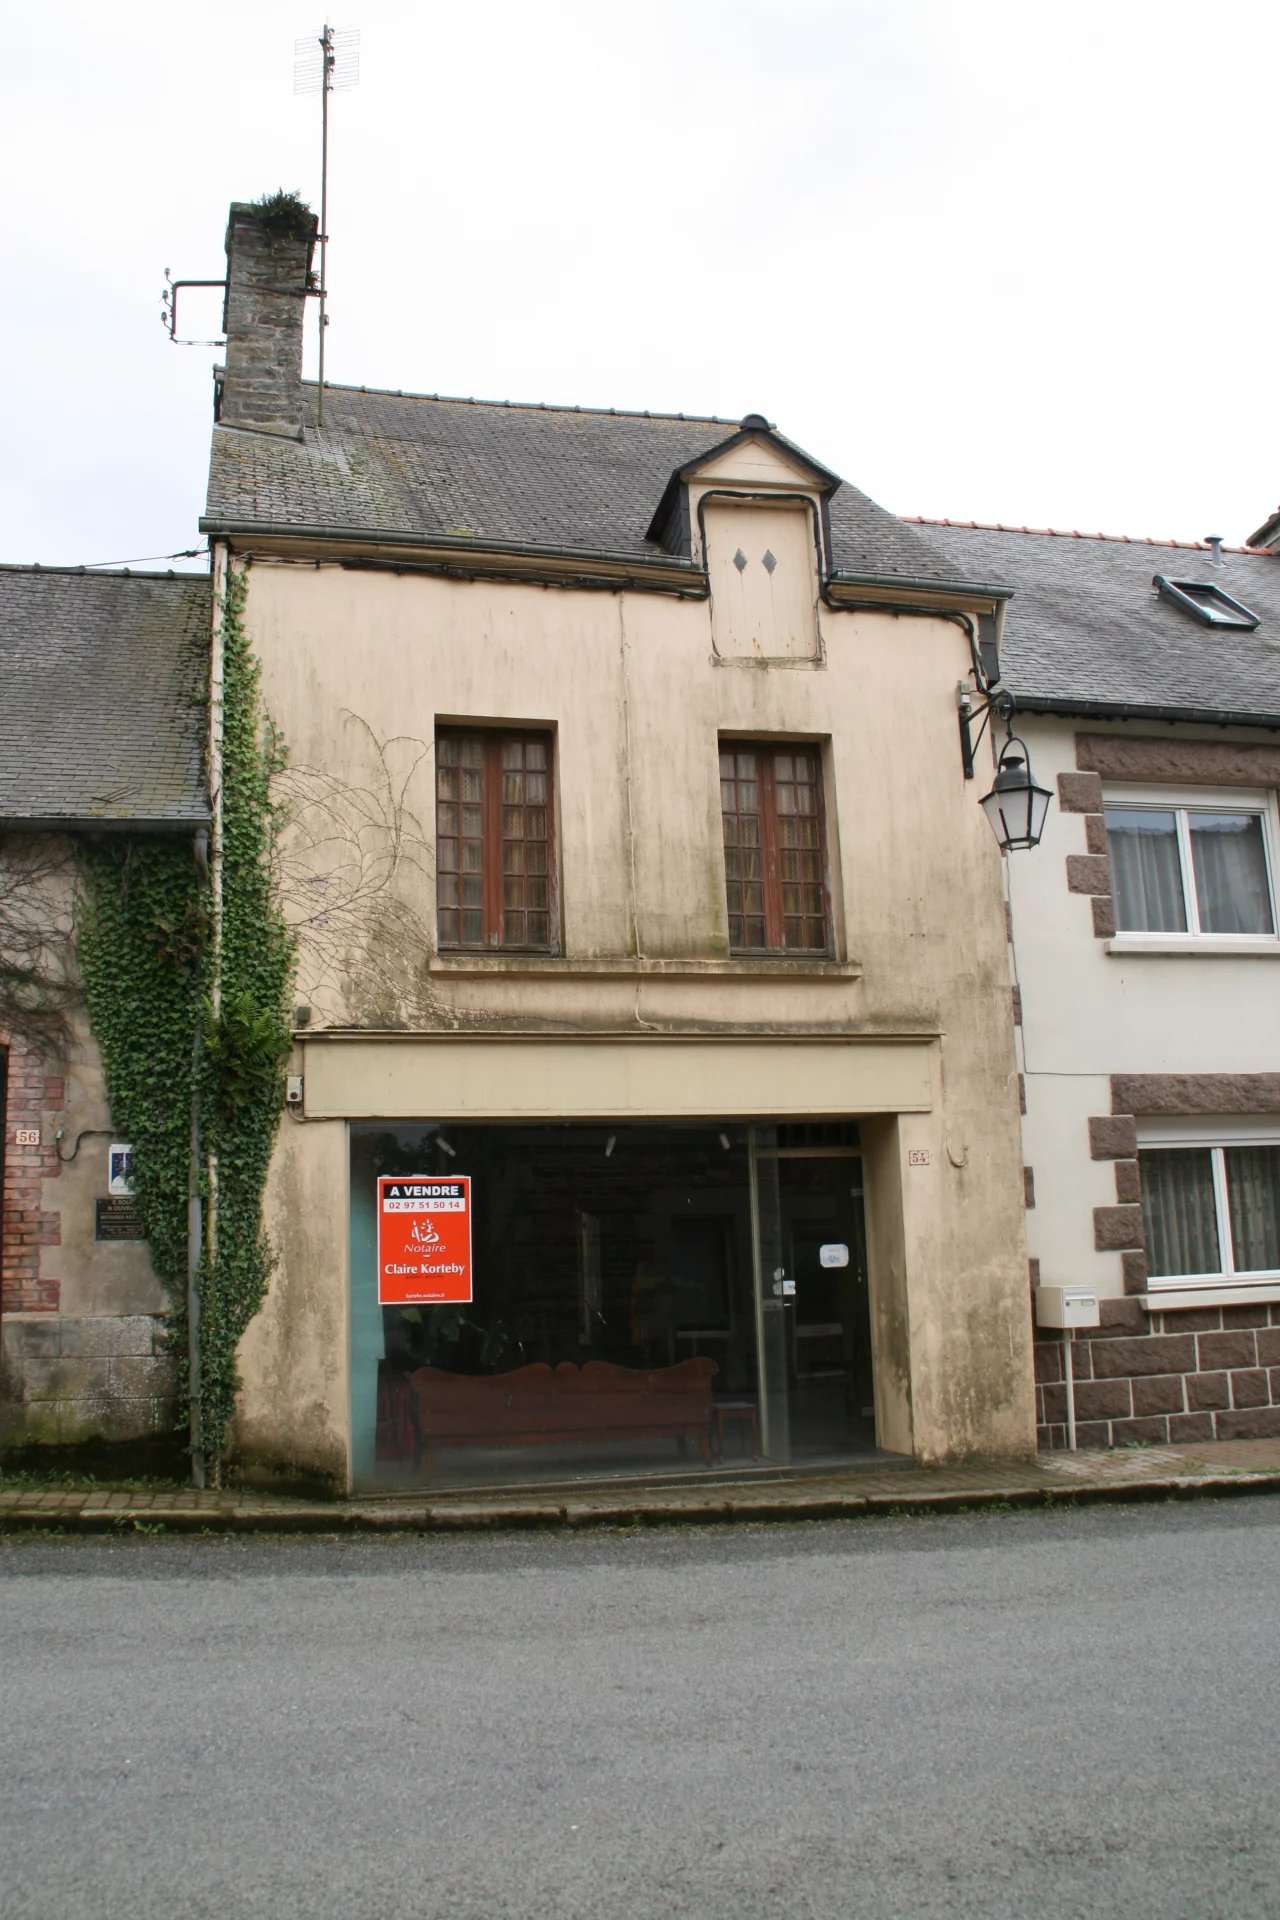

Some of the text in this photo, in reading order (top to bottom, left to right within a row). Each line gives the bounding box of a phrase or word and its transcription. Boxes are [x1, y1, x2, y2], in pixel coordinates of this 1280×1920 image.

[20, 1131, 36, 1143] 56
[390, 1185, 459, 1196] A VENDRE
[419, 1201, 430, 1209] 51
[434, 1201, 445, 1209] 50
[449, 1201, 460, 1209] 14
[404, 1243, 447, 1253] Notaire
[385, 1263, 465, 1276] Claire Korteby
